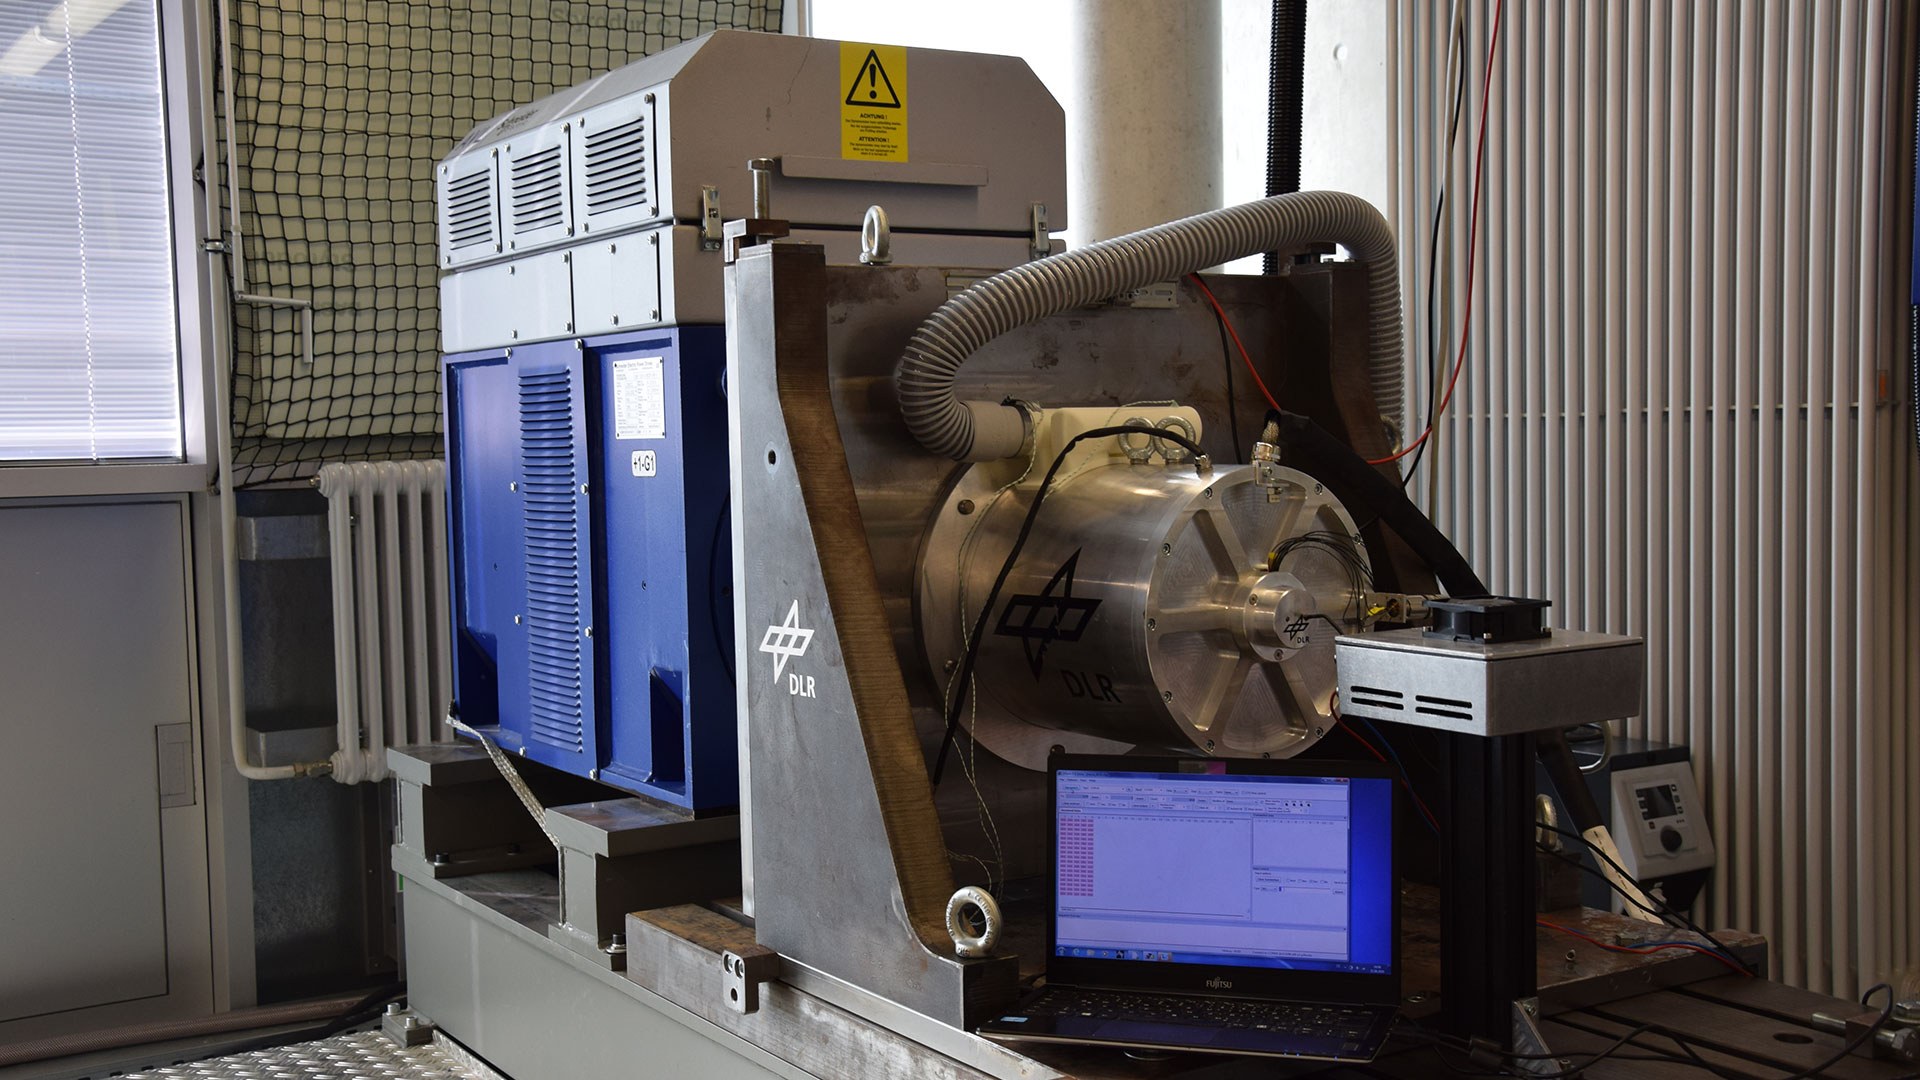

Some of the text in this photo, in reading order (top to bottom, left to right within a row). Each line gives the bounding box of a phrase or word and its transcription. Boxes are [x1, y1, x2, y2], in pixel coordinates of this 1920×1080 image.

[633, 455, 655, 471] +1-G1
[1297, 636, 1310, 644] DLR
[789, 673, 816, 698] DLR
[1060, 669, 1122, 703] DLR
[1206, 976, 1232, 989] FUJITSU
